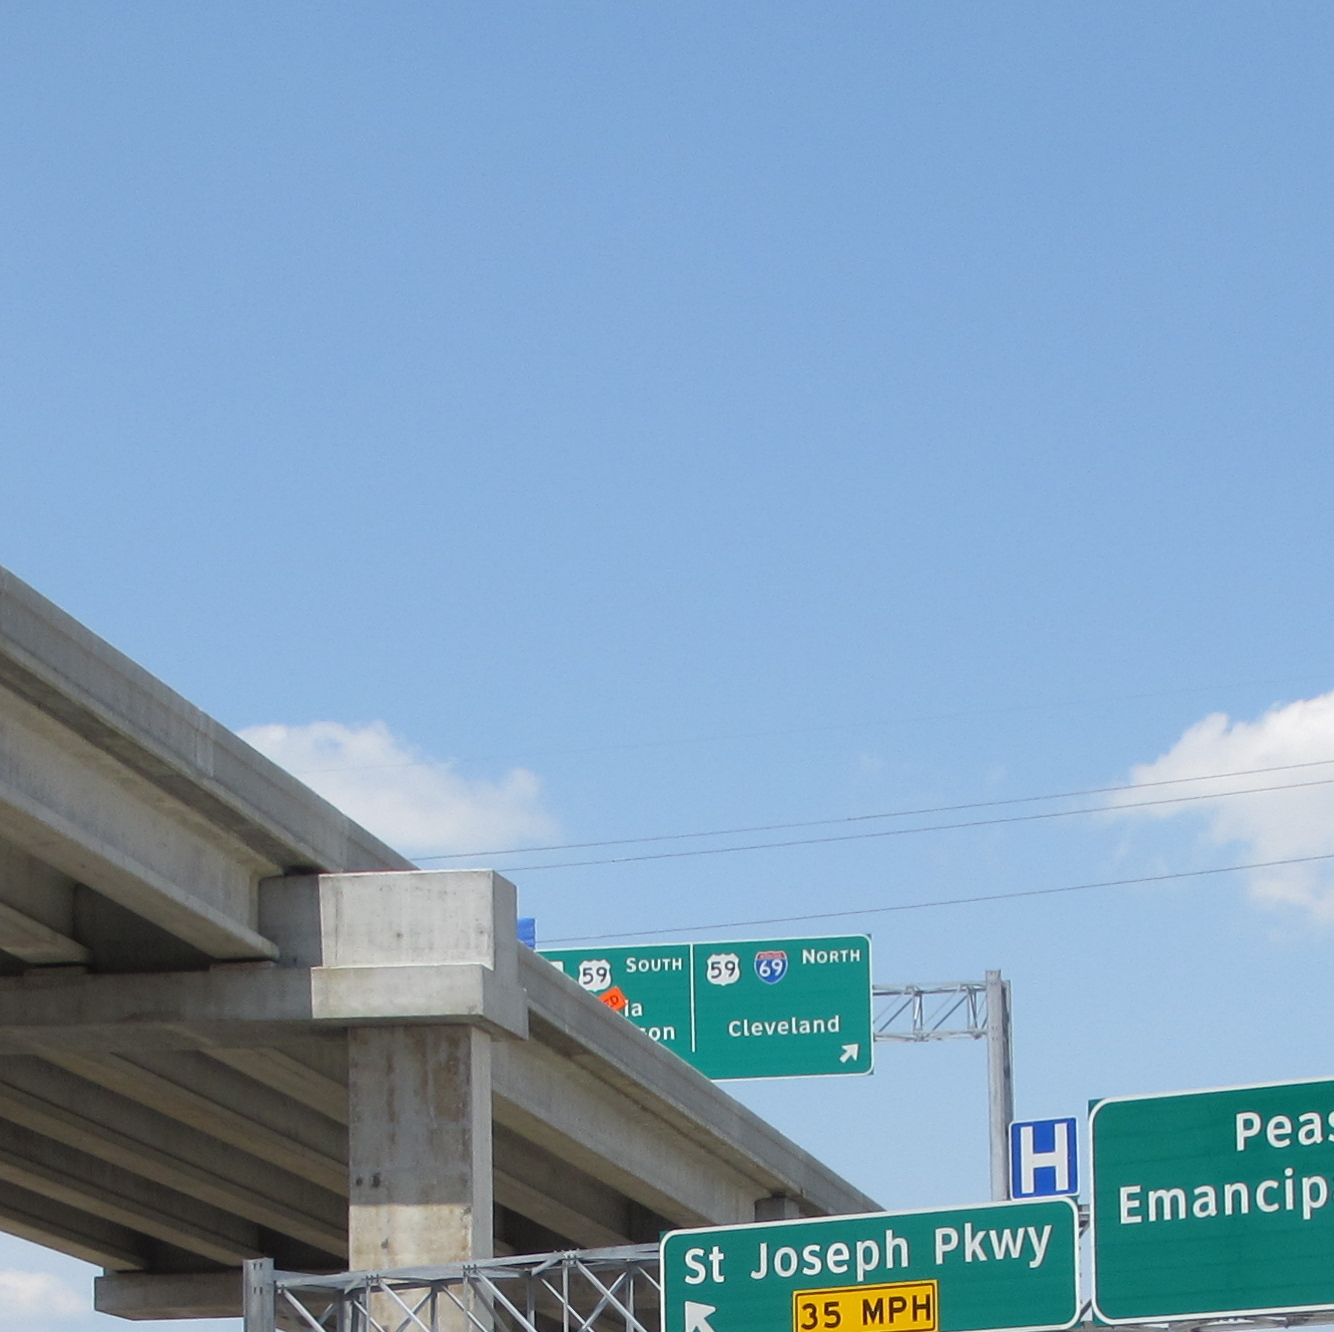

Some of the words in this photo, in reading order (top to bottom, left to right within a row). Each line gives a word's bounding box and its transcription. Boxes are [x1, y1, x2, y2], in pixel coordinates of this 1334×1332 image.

[582, 966, 607, 985] 59
[626, 957, 683, 973] SOUTH
[710, 961, 736, 979] 59
[759, 960, 783, 977] 69
[802, 949, 861, 965] NORTH
[728, 1015, 840, 1037] Cleveland
[1020, 1122, 1069, 1194] H
[684, 1245, 725, 1285] St
[750, 1229, 909, 1282] Joseph
[934, 1222, 1053, 1269] Pkwy
[800, 1301, 842, 1330] 35
[862, 1293, 932, 1326] MPH
